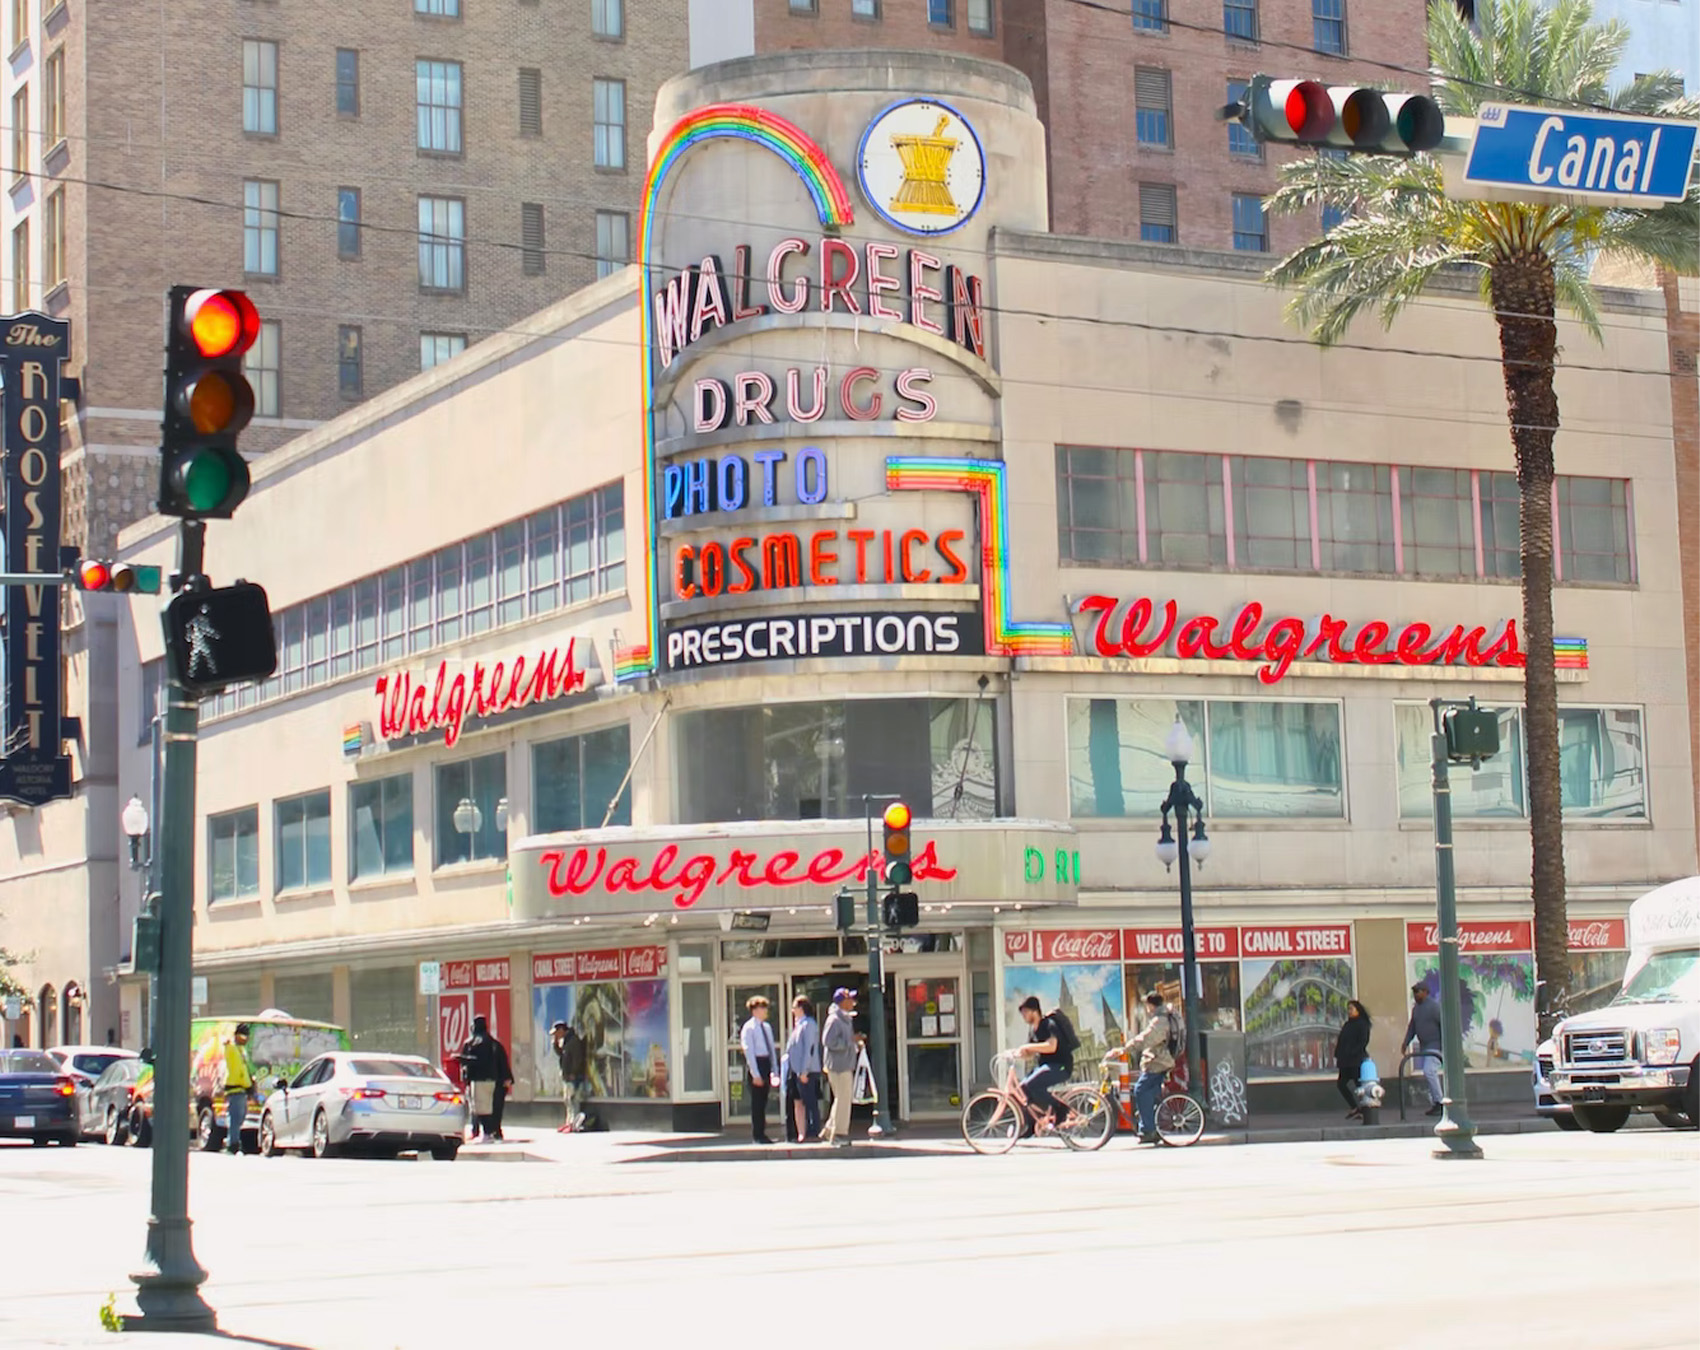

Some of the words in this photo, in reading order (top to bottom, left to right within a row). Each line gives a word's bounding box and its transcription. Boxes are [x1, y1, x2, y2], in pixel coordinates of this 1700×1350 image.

[1528, 117, 1661, 192] Canal
[6, 324, 61, 346] The
[655, 237, 986, 368] WALGREEN
[694, 366, 938, 432] DRUGS
[664, 447, 827, 518] PHOTO
[20, 362, 48, 748] ROOSEVELT
[675, 529, 967, 599] COSMETICS
[667, 616, 959, 667] PRESCRIPTIONS
[1076, 595, 1527, 685] Walgreens
[376, 636, 585, 748] Walgreens
[578, 954, 619, 979] Walgreens
[1007, 933, 1026, 950] W
[1136, 933, 1204, 953] WELCOE
[1208, 933, 1226, 952] TO
[1244, 931, 1292, 952] CANAL
[1296, 930, 1346, 950] STREET
[1424, 926, 1514, 951] Wlgreens
